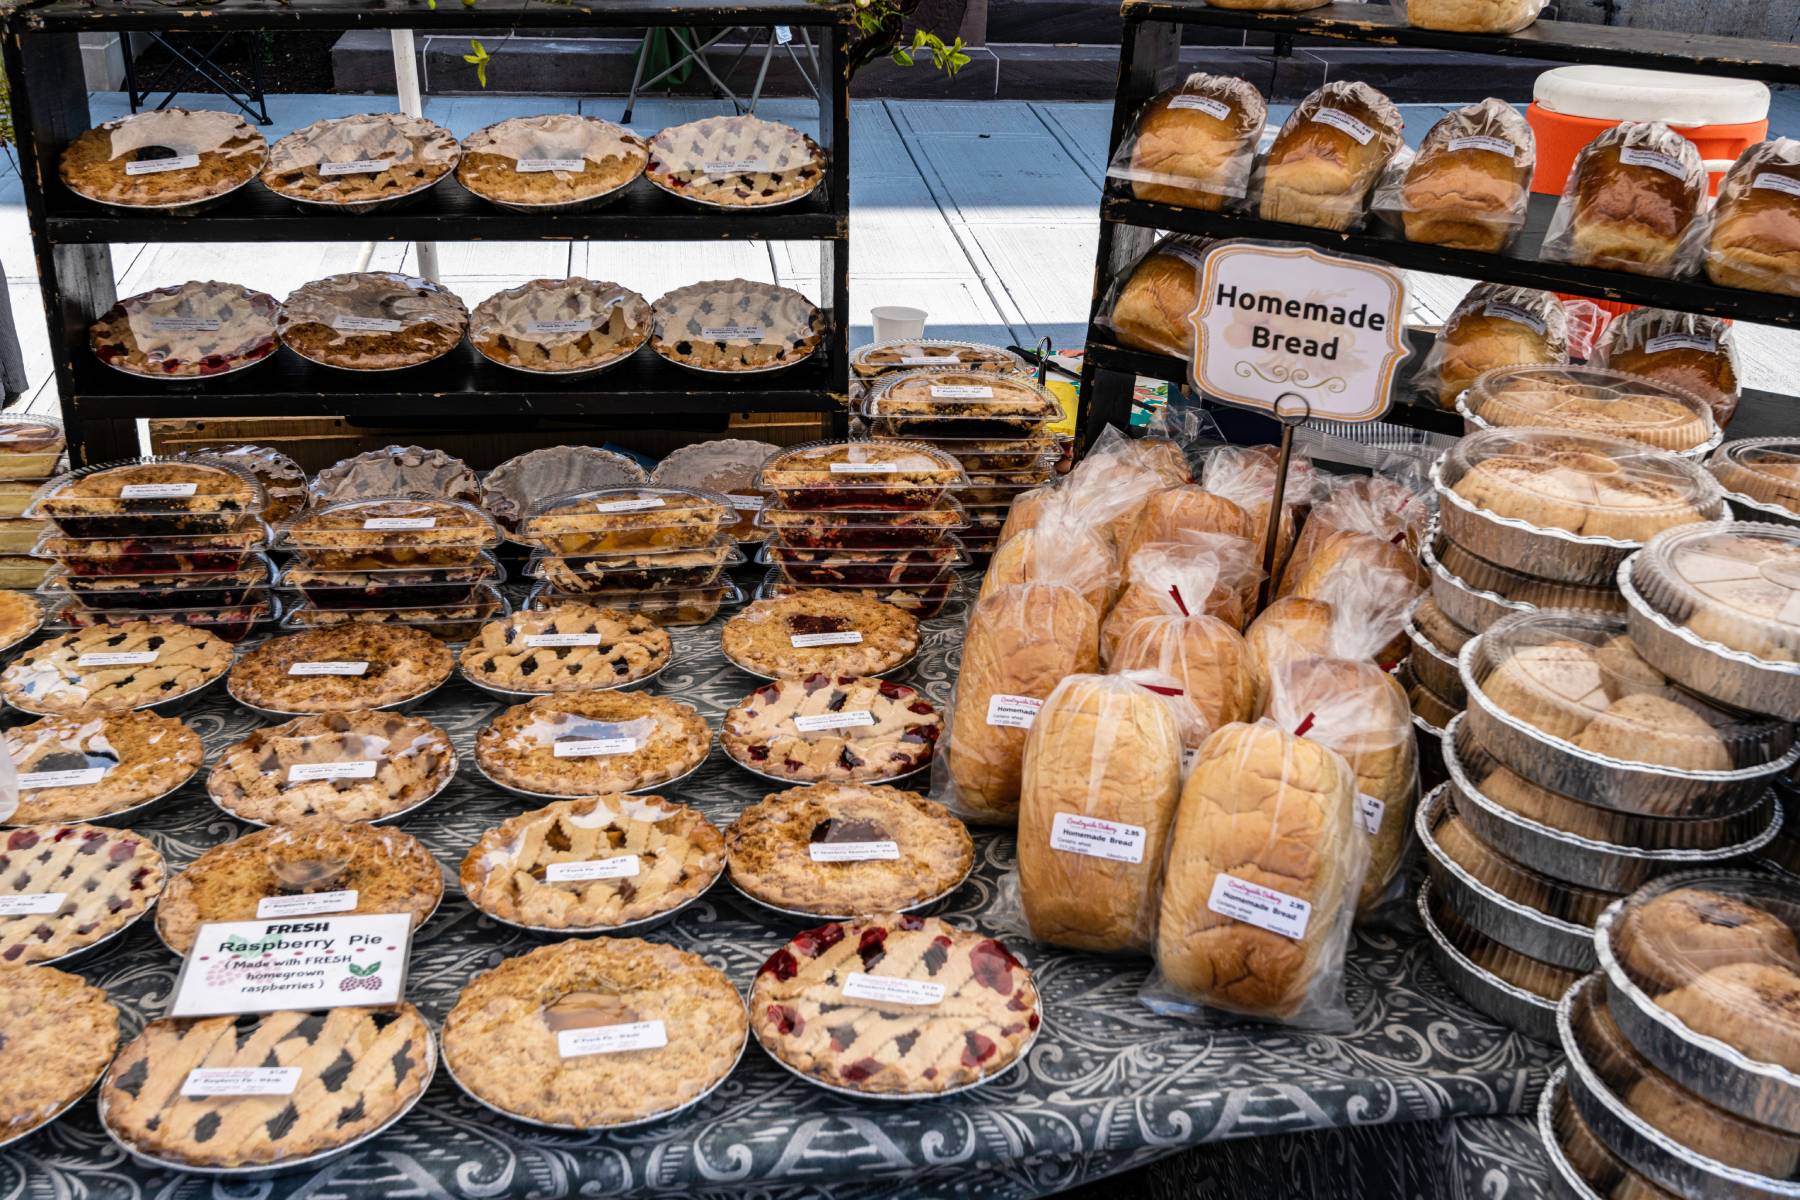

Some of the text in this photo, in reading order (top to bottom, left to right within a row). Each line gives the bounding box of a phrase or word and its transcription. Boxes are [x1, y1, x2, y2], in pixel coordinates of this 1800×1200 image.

[1216, 283, 1386, 331] Homemade
[1251, 325, 1340, 361] Bread
[997, 706, 1036, 716] Homemade
[1063, 828, 1106, 843] Homemade
[1109, 837, 1133, 847] Bread
[1222, 890, 1297, 921] Homemade Bread
[265, 922, 330, 935] FRESH
[218, 935, 383, 954] Raspberry Pie
[274, 957, 301, 967] with
[305, 955, 352, 965] FRESH
[246, 969, 325, 981] homegrown
[241, 981, 315, 994] raspberries
